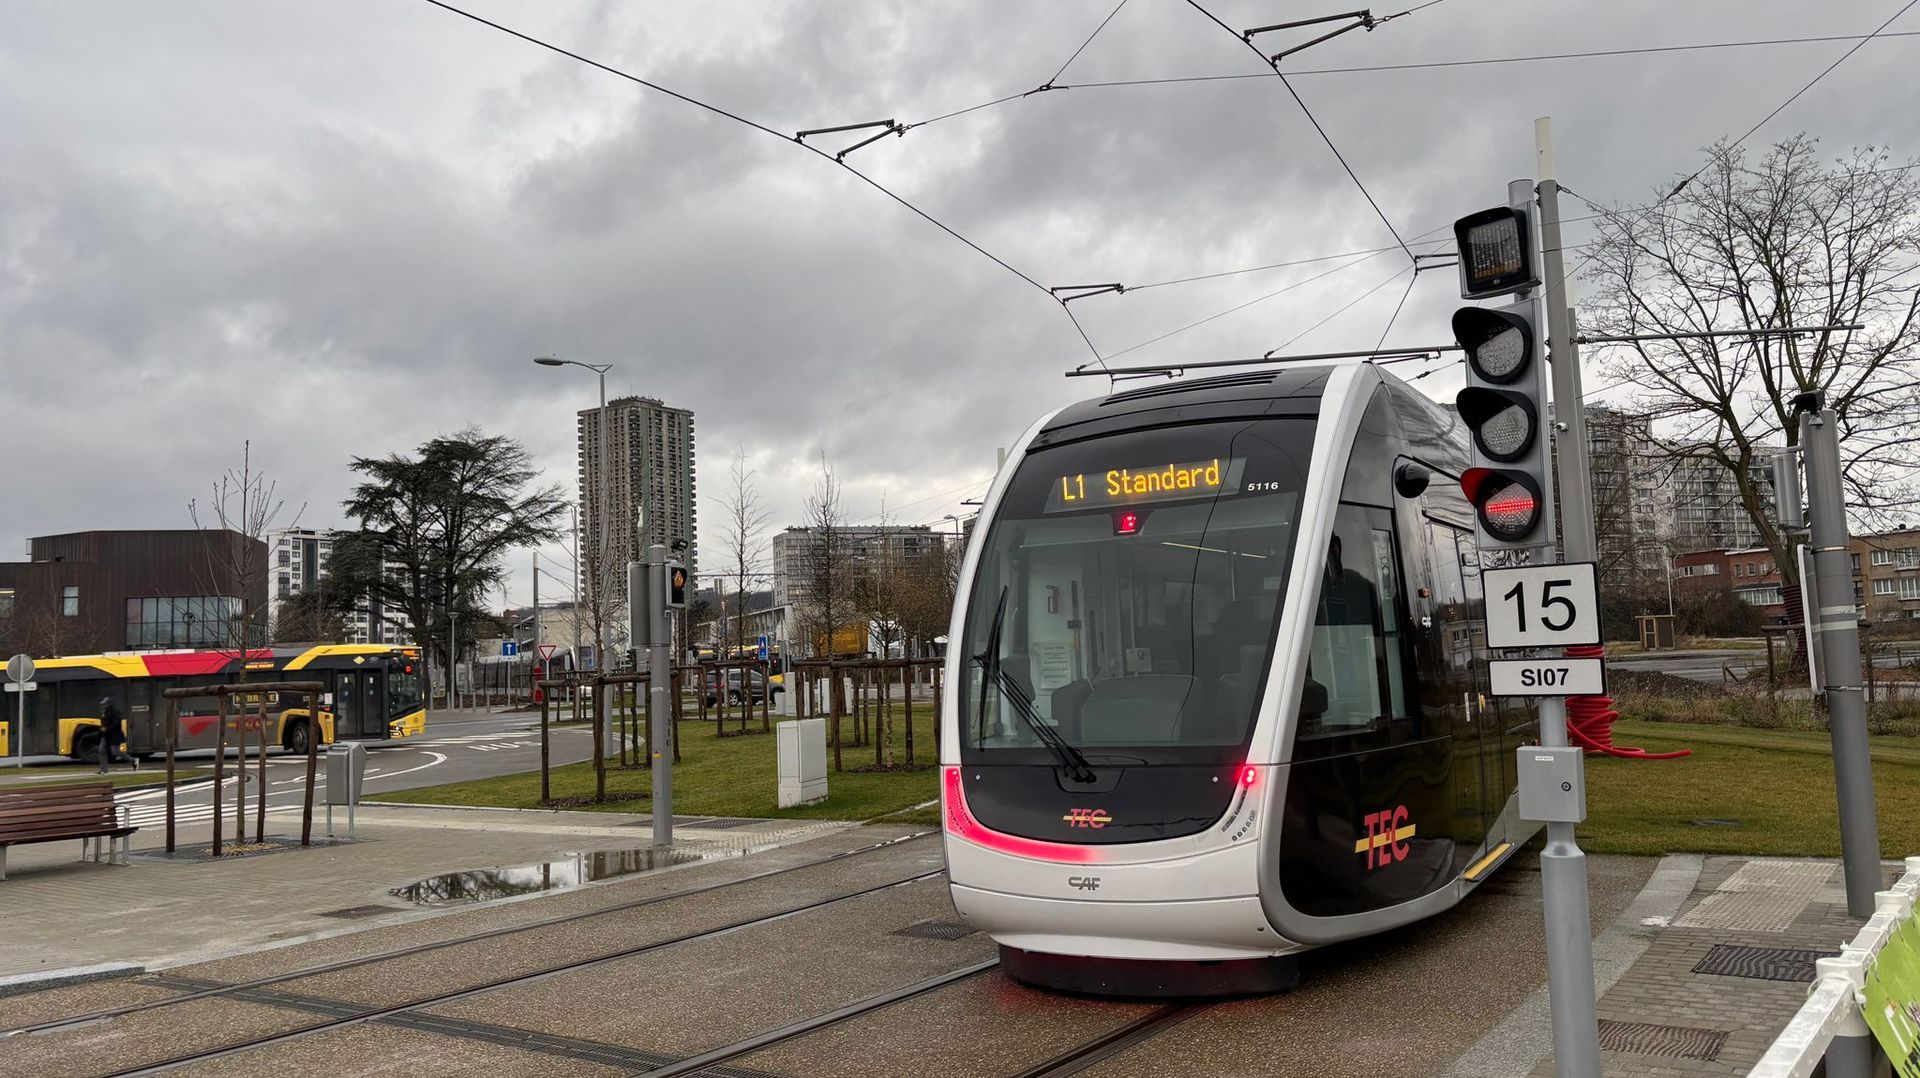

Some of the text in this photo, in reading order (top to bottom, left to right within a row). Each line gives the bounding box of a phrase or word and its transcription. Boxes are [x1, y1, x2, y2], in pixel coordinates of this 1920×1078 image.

[1063, 458, 1220, 500] L1 Standard
[1248, 481, 1279, 491] 5116
[1504, 579, 1576, 633] 15
[1521, 668, 1570, 687] SI07
[1071, 808, 1107, 828] TEC
[1364, 804, 1410, 870] TEC
[1068, 876, 1101, 891] CAF
